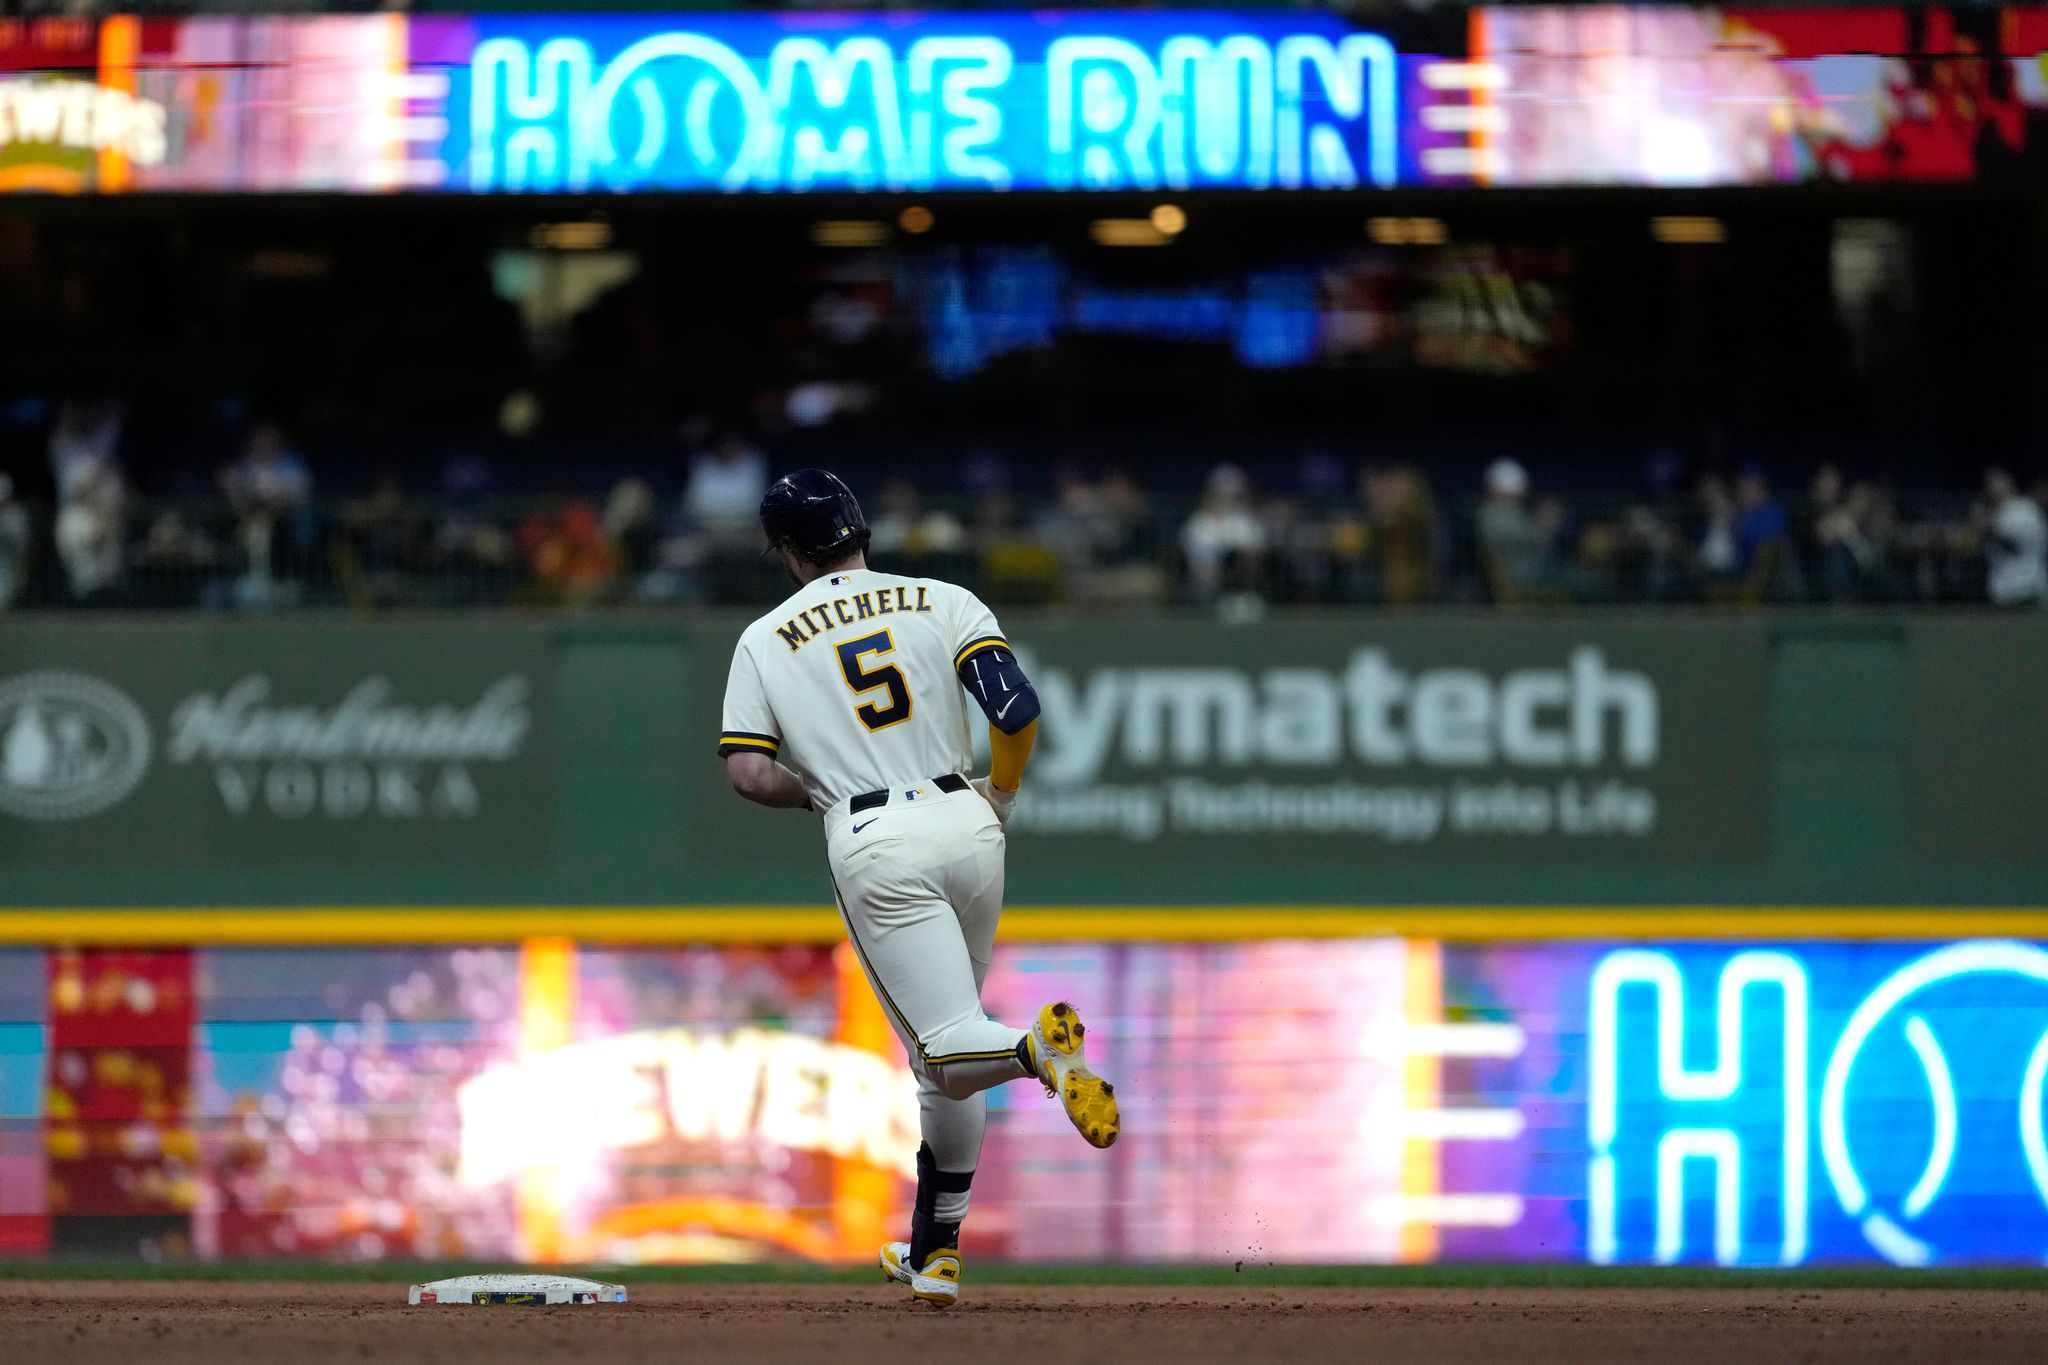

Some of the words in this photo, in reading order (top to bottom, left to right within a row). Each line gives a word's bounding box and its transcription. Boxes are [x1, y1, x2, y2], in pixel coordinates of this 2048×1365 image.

[469, 32, 1014, 193] HOME
[1047, 34, 1397, 189] RUN
[774, 586, 933, 654] MITCHELL
[833, 627, 913, 733] 5
[212, 762, 482, 819] VODKA
[939, 1268, 957, 1278] NIKE
